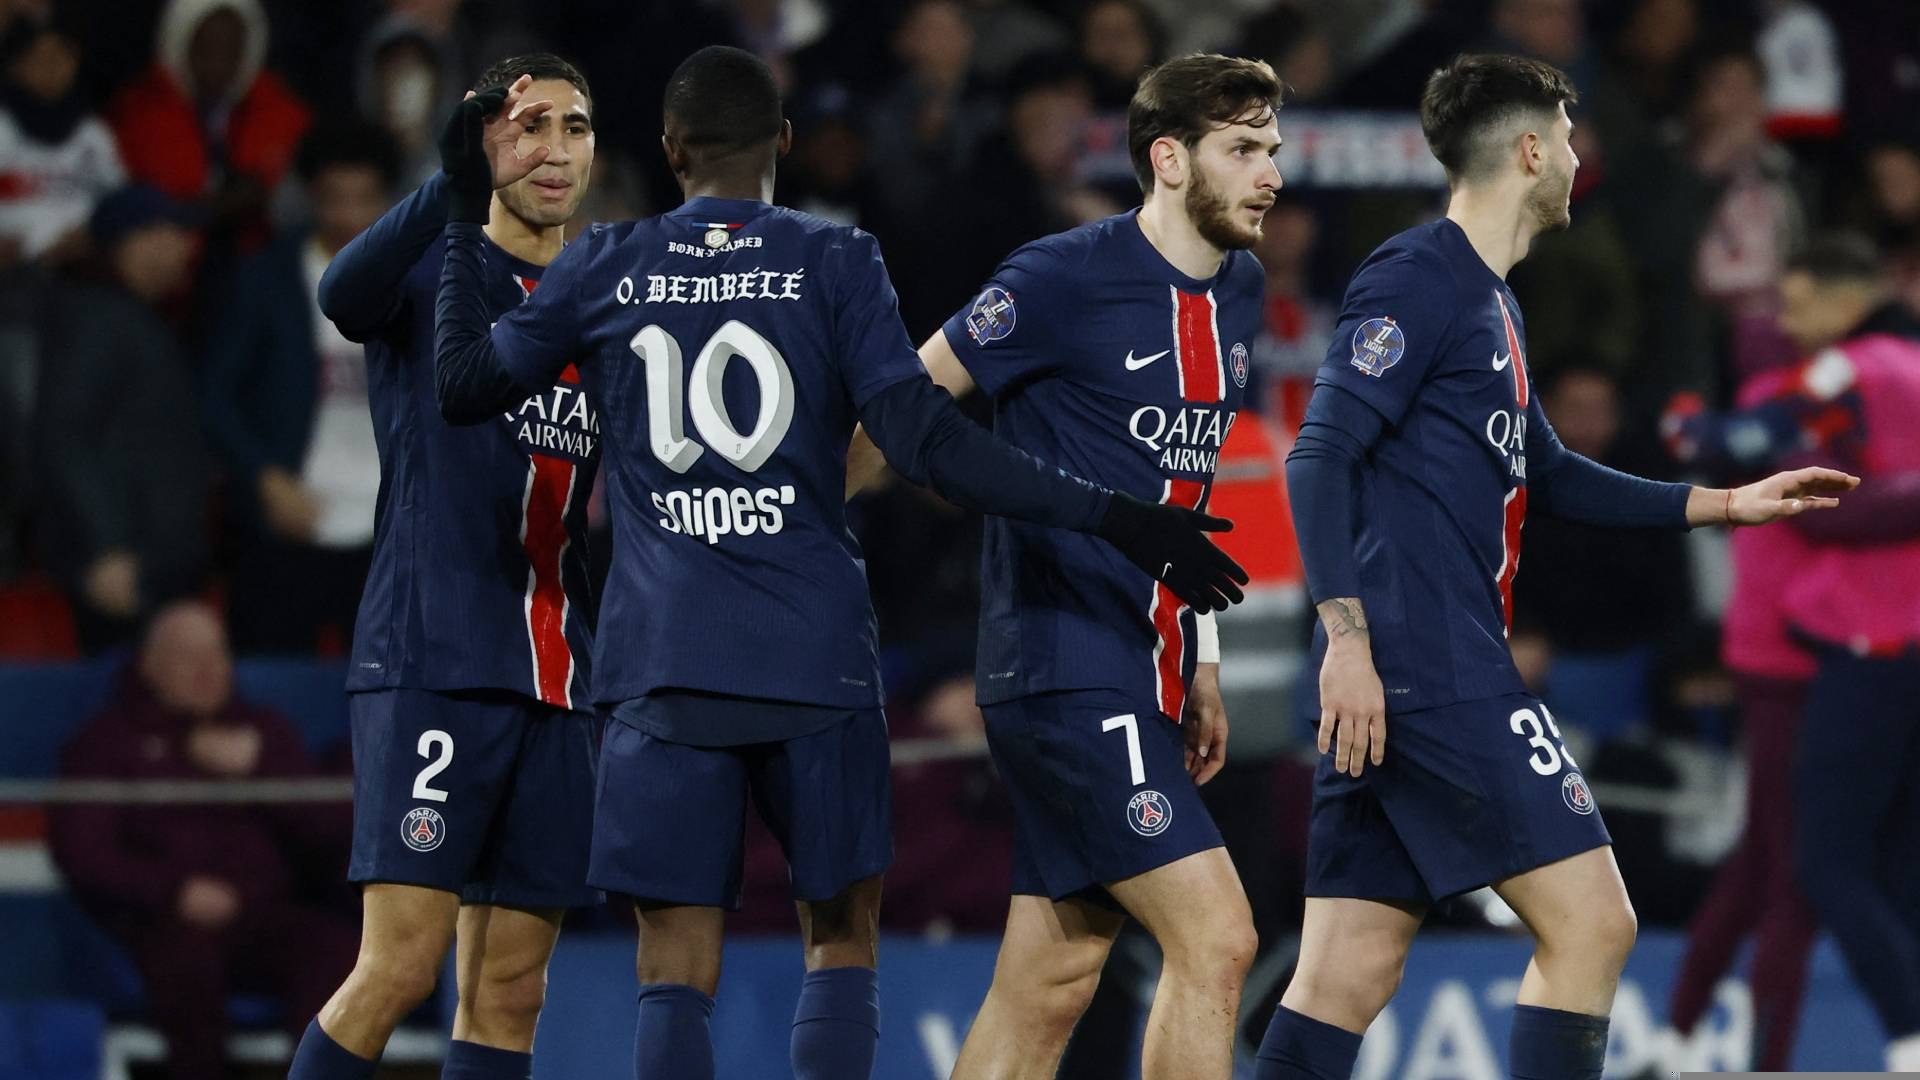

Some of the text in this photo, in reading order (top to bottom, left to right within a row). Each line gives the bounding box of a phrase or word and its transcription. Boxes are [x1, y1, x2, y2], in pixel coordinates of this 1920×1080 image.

[616, 266, 805, 305] O. DEMBÉLÉ
[1363, 338, 1386, 357] LIGUE
[504, 386, 601, 435] ATA
[629, 319, 796, 474] 10
[651, 485, 796, 545] snipes
[412, 729, 454, 803] 2
[1101, 713, 1146, 786] 7
[409, 809, 440, 823] PARIS
[1129, 792, 1159, 810] PARIS
